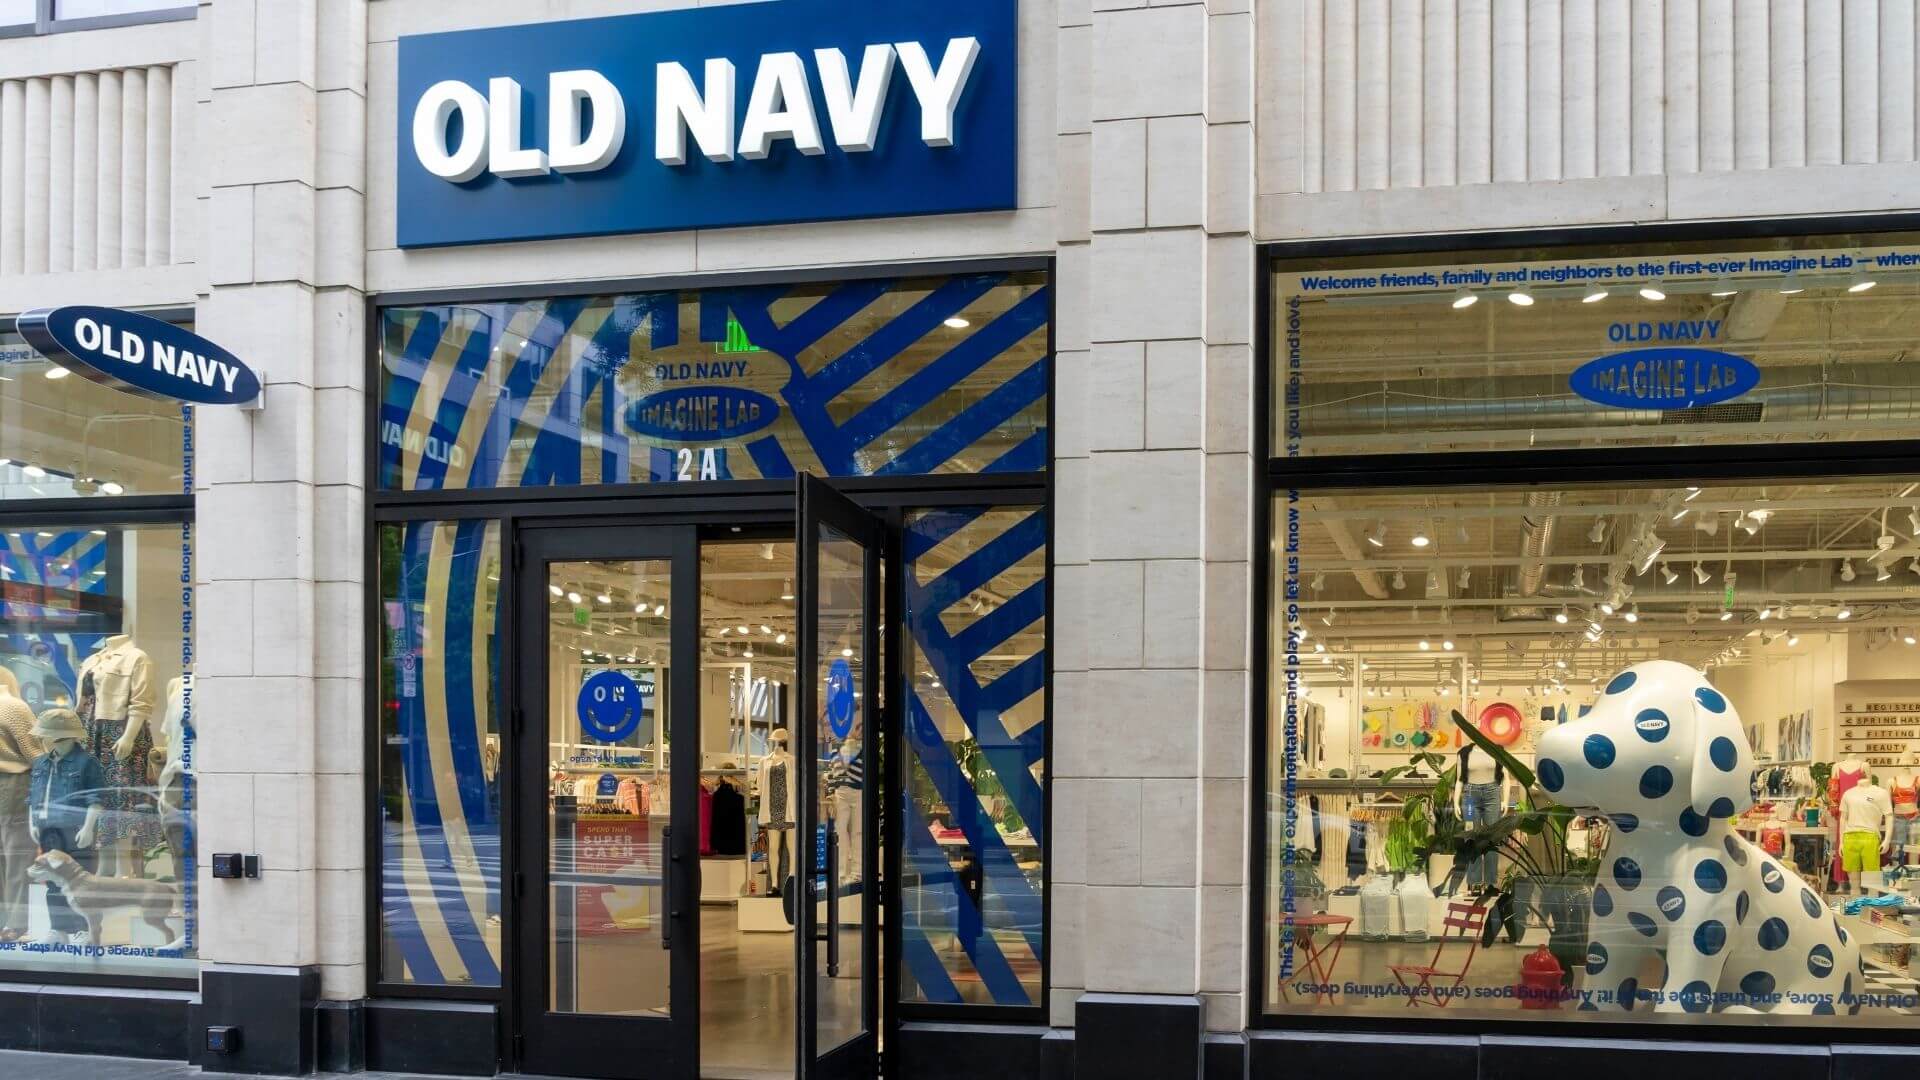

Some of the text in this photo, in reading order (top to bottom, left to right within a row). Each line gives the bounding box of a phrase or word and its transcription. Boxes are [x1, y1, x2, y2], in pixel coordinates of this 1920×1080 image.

[413, 36, 982, 183] OLD NAVY
[1301, 274, 1377, 291] Welcome
[1380, 272, 1439, 288] friends,
[1442, 269, 1492, 286] family
[1496, 267, 1527, 282] and
[1530, 264, 1611, 283] neighbors
[1616, 264, 1634, 277] to
[1638, 262, 1664, 276] the
[1669, 259, 1744, 275] first-ever
[1749, 256, 1817, 273] Imagine
[1821, 253, 1853, 268] Lab
[1287, 294, 1301, 334] love.
[1608, 320, 1720, 342] OLD NAVY
[74, 317, 240, 393] OLD NAVY
[1287, 337, 1300, 368] and
[655, 360, 747, 380] OLD NAVY
[1592, 359, 1736, 400] IMAGINE LAB
[642, 396, 760, 432] IMAGINE LAB
[1288, 410, 1302, 440] you
[183, 426, 194, 452] and
[1286, 508, 1299, 552] know
[180, 543, 193, 582] along
[1287, 556, 1298, 574] us
[182, 587, 192, 607] for
[1285, 578, 1298, 599] let
[182, 610, 192, 633] the
[1286, 603, 1298, 623] so
[182, 637, 192, 668] ride.
[1284, 625, 1301, 665] play,
[183, 672, 192, 684] In
[1284, 670, 1298, 697] and
[635, 684, 655, 693] AVY
[1283, 704, 1298, 838] experimentation
[584, 835, 632, 844] SUPER
[1280, 869, 1297, 913] place
[1284, 916, 1294, 926] a
[184, 918, 194, 949] than
[1283, 930, 1294, 943] is
[18, 942, 50, 954] store,
[53, 943, 82, 956] Navy
[84, 946, 104, 957] Old
[107, 945, 154, 957] average
[1280, 946, 1293, 978] This
[1290, 982, 1340, 998] does).
[1344, 982, 1428, 998] everything
[1434, 984, 1470, 1000] (and
[1474, 984, 1512, 998] goes
[1597, 990, 1613, 1004] it!
[1752, 991, 1782, 1006] and
[1786, 990, 1833, 1006] store,
[1838, 992, 1881, 1008] Navy
[1886, 994, 1916, 1008] Old
